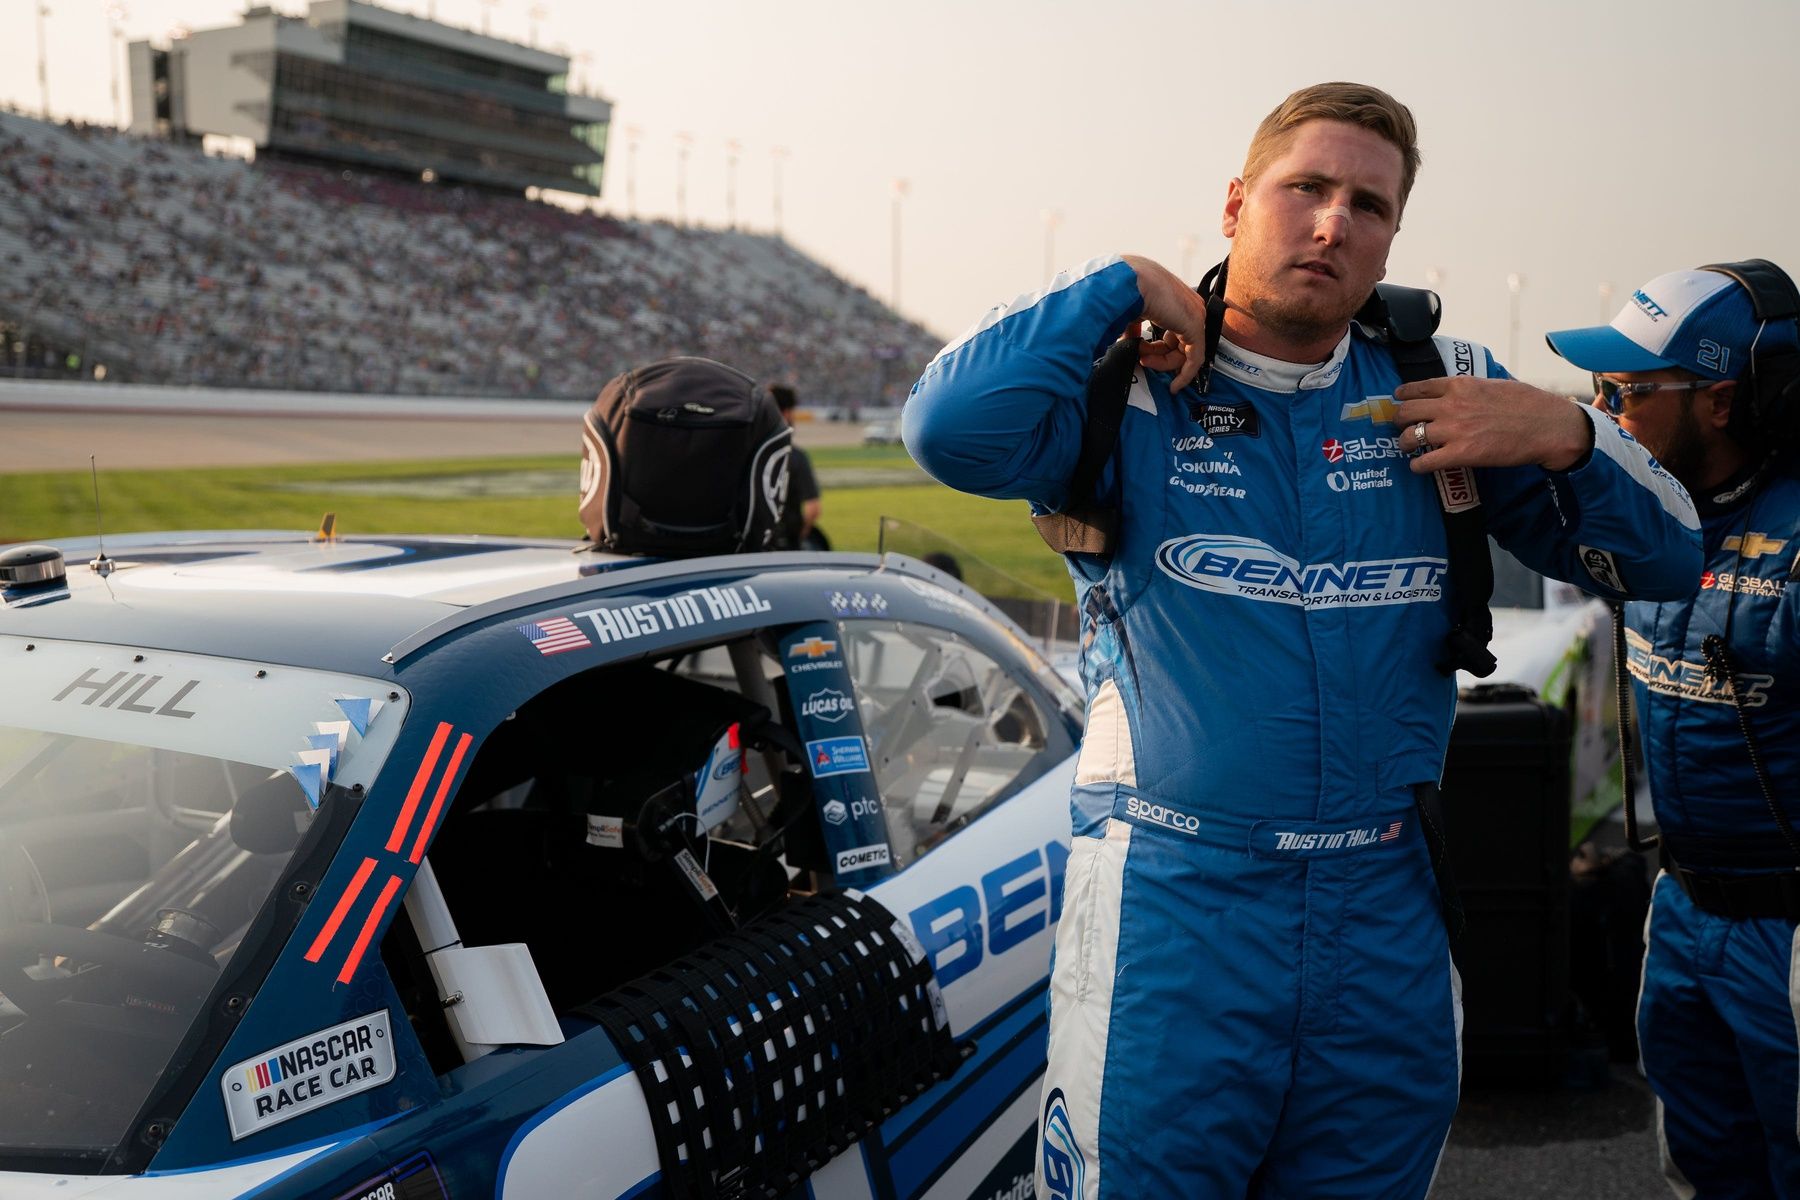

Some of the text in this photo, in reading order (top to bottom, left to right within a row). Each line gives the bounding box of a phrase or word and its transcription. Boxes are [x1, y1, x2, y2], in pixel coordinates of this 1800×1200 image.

[1216, 351, 1263, 373] ENNETT
[1453, 340, 1471, 376] arco
[1697, 338, 1730, 374] 21
[1208, 405, 1236, 413] NASCAR
[1198, 413, 1245, 428] finity
[1208, 426, 1231, 435] SERIES
[1343, 437, 1401, 452] GLOB
[1182, 462, 1242, 476] OKUMA
[1351, 468, 1388, 481] United
[1353, 478, 1393, 491] Rentals
[1190, 551, 1447, 593] BENNETT
[1718, 573, 1785, 591] GLOBAL
[1237, 585, 1440, 606] TRANSPORTATION & LOGSTICS
[574, 585, 771, 644] AUSTIN HILL
[791, 661, 843, 673] CHEVROLET
[52, 668, 200, 719] HILL
[802, 698, 854, 716] LUCAS OIL
[851, 797, 878, 820] ptc
[1127, 797, 1200, 834] sparco
[1275, 827, 1378, 850] AUSTIN HILL
[840, 849, 888, 868] COMETIC
[279, 1025, 373, 1080] NASCAR
[255, 1056, 377, 1118] RACE CAR
